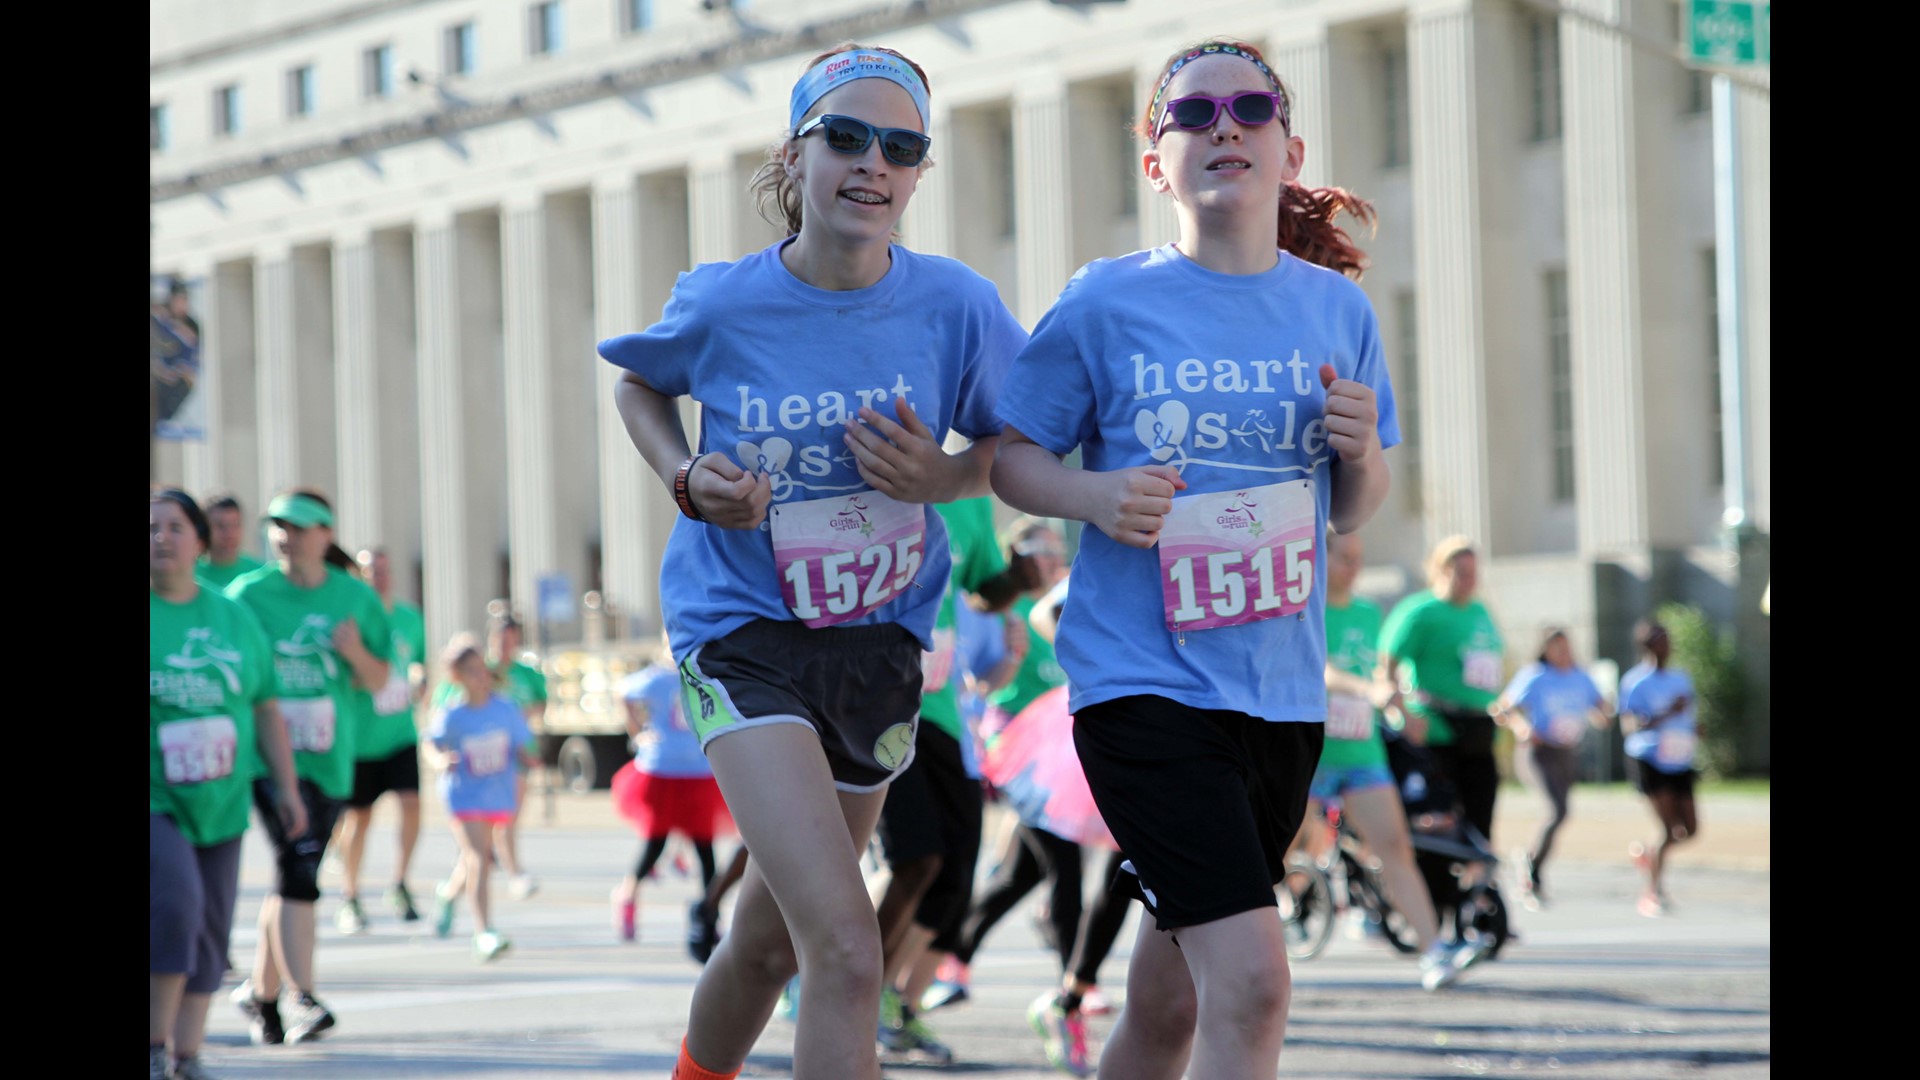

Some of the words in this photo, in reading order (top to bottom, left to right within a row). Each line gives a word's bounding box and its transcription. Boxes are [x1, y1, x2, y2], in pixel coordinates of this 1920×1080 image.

[825, 59, 850, 75] Run
[838, 65, 856, 77] TRY
[1130, 348, 1312, 400] heart
[736, 373, 916, 433] heart
[829, 517, 853, 528] Girls
[842, 522, 861, 531] run
[1216, 515, 1241, 525] Girls
[1229, 521, 1249, 529] run
[784, 532, 923, 620] 1525
[1169, 538, 1313, 623] 1515
